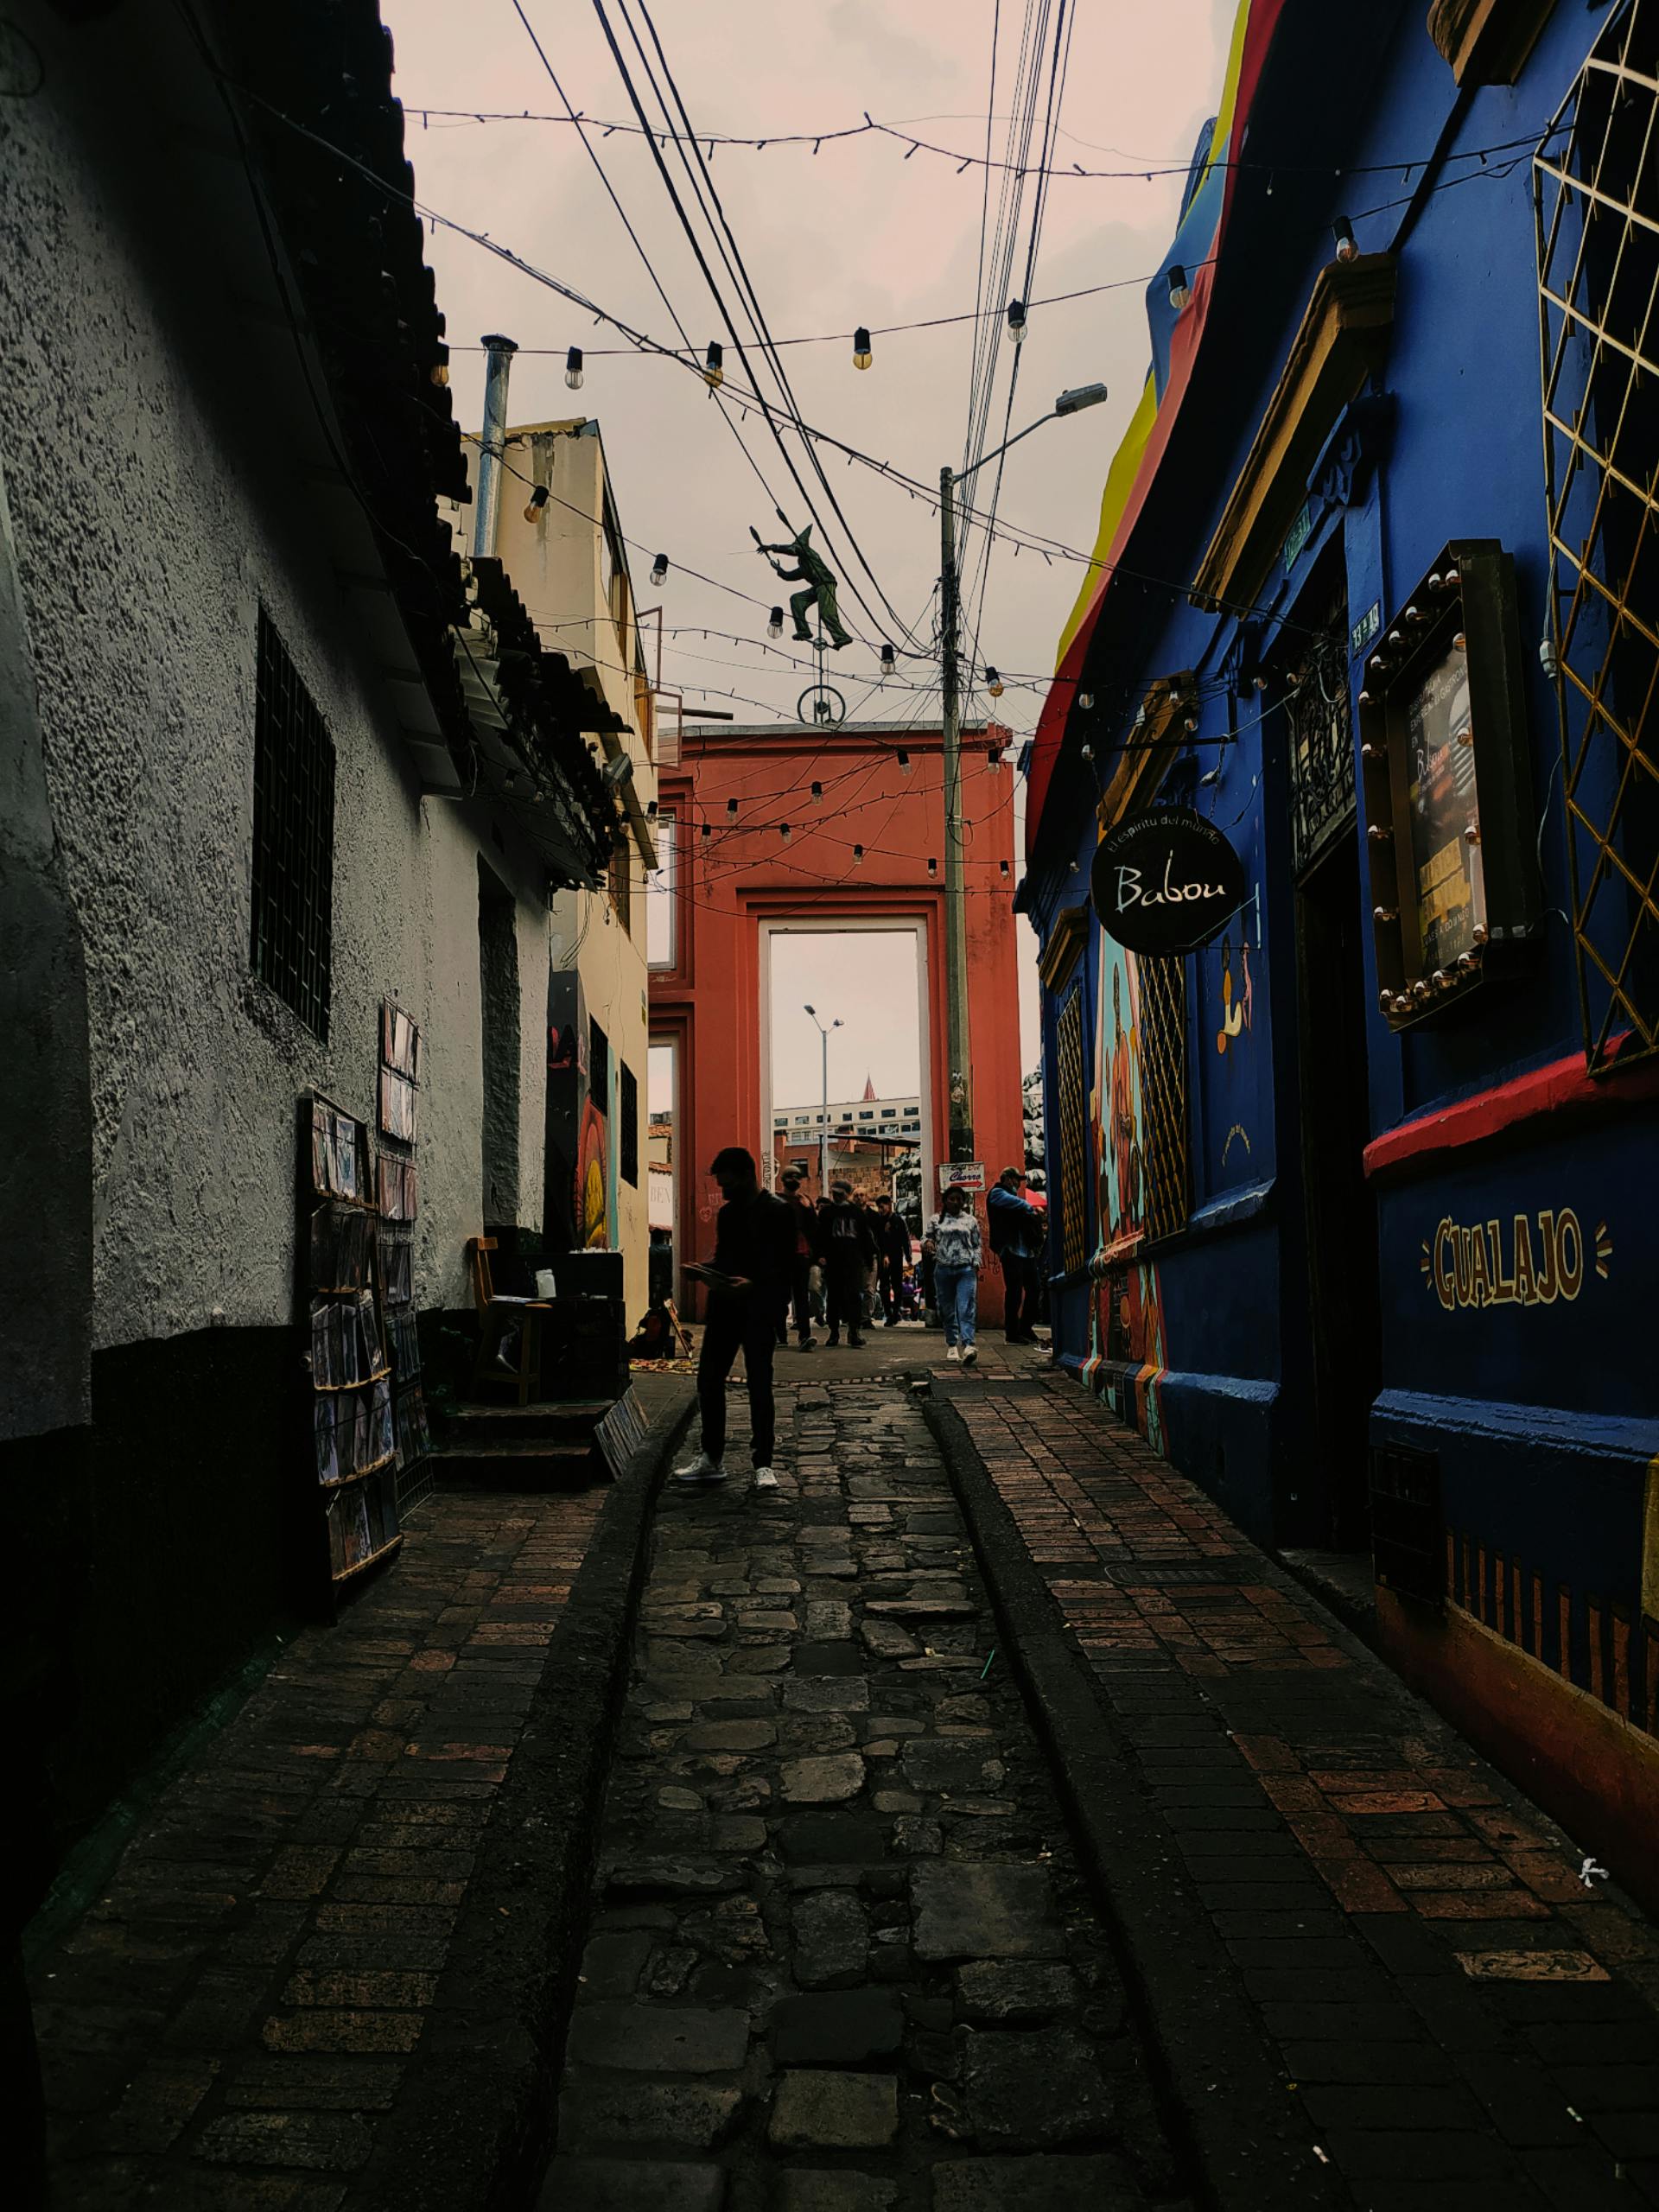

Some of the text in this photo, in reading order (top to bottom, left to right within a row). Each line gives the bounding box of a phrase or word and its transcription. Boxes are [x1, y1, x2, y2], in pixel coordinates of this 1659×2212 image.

[1107, 840, 1119, 853] El
[1160, 814, 1179, 825] del
[1181, 818, 1220, 845] mundo
[1113, 849, 1227, 913] Babou
[1434, 1207, 1584, 1312] GUALAJO
